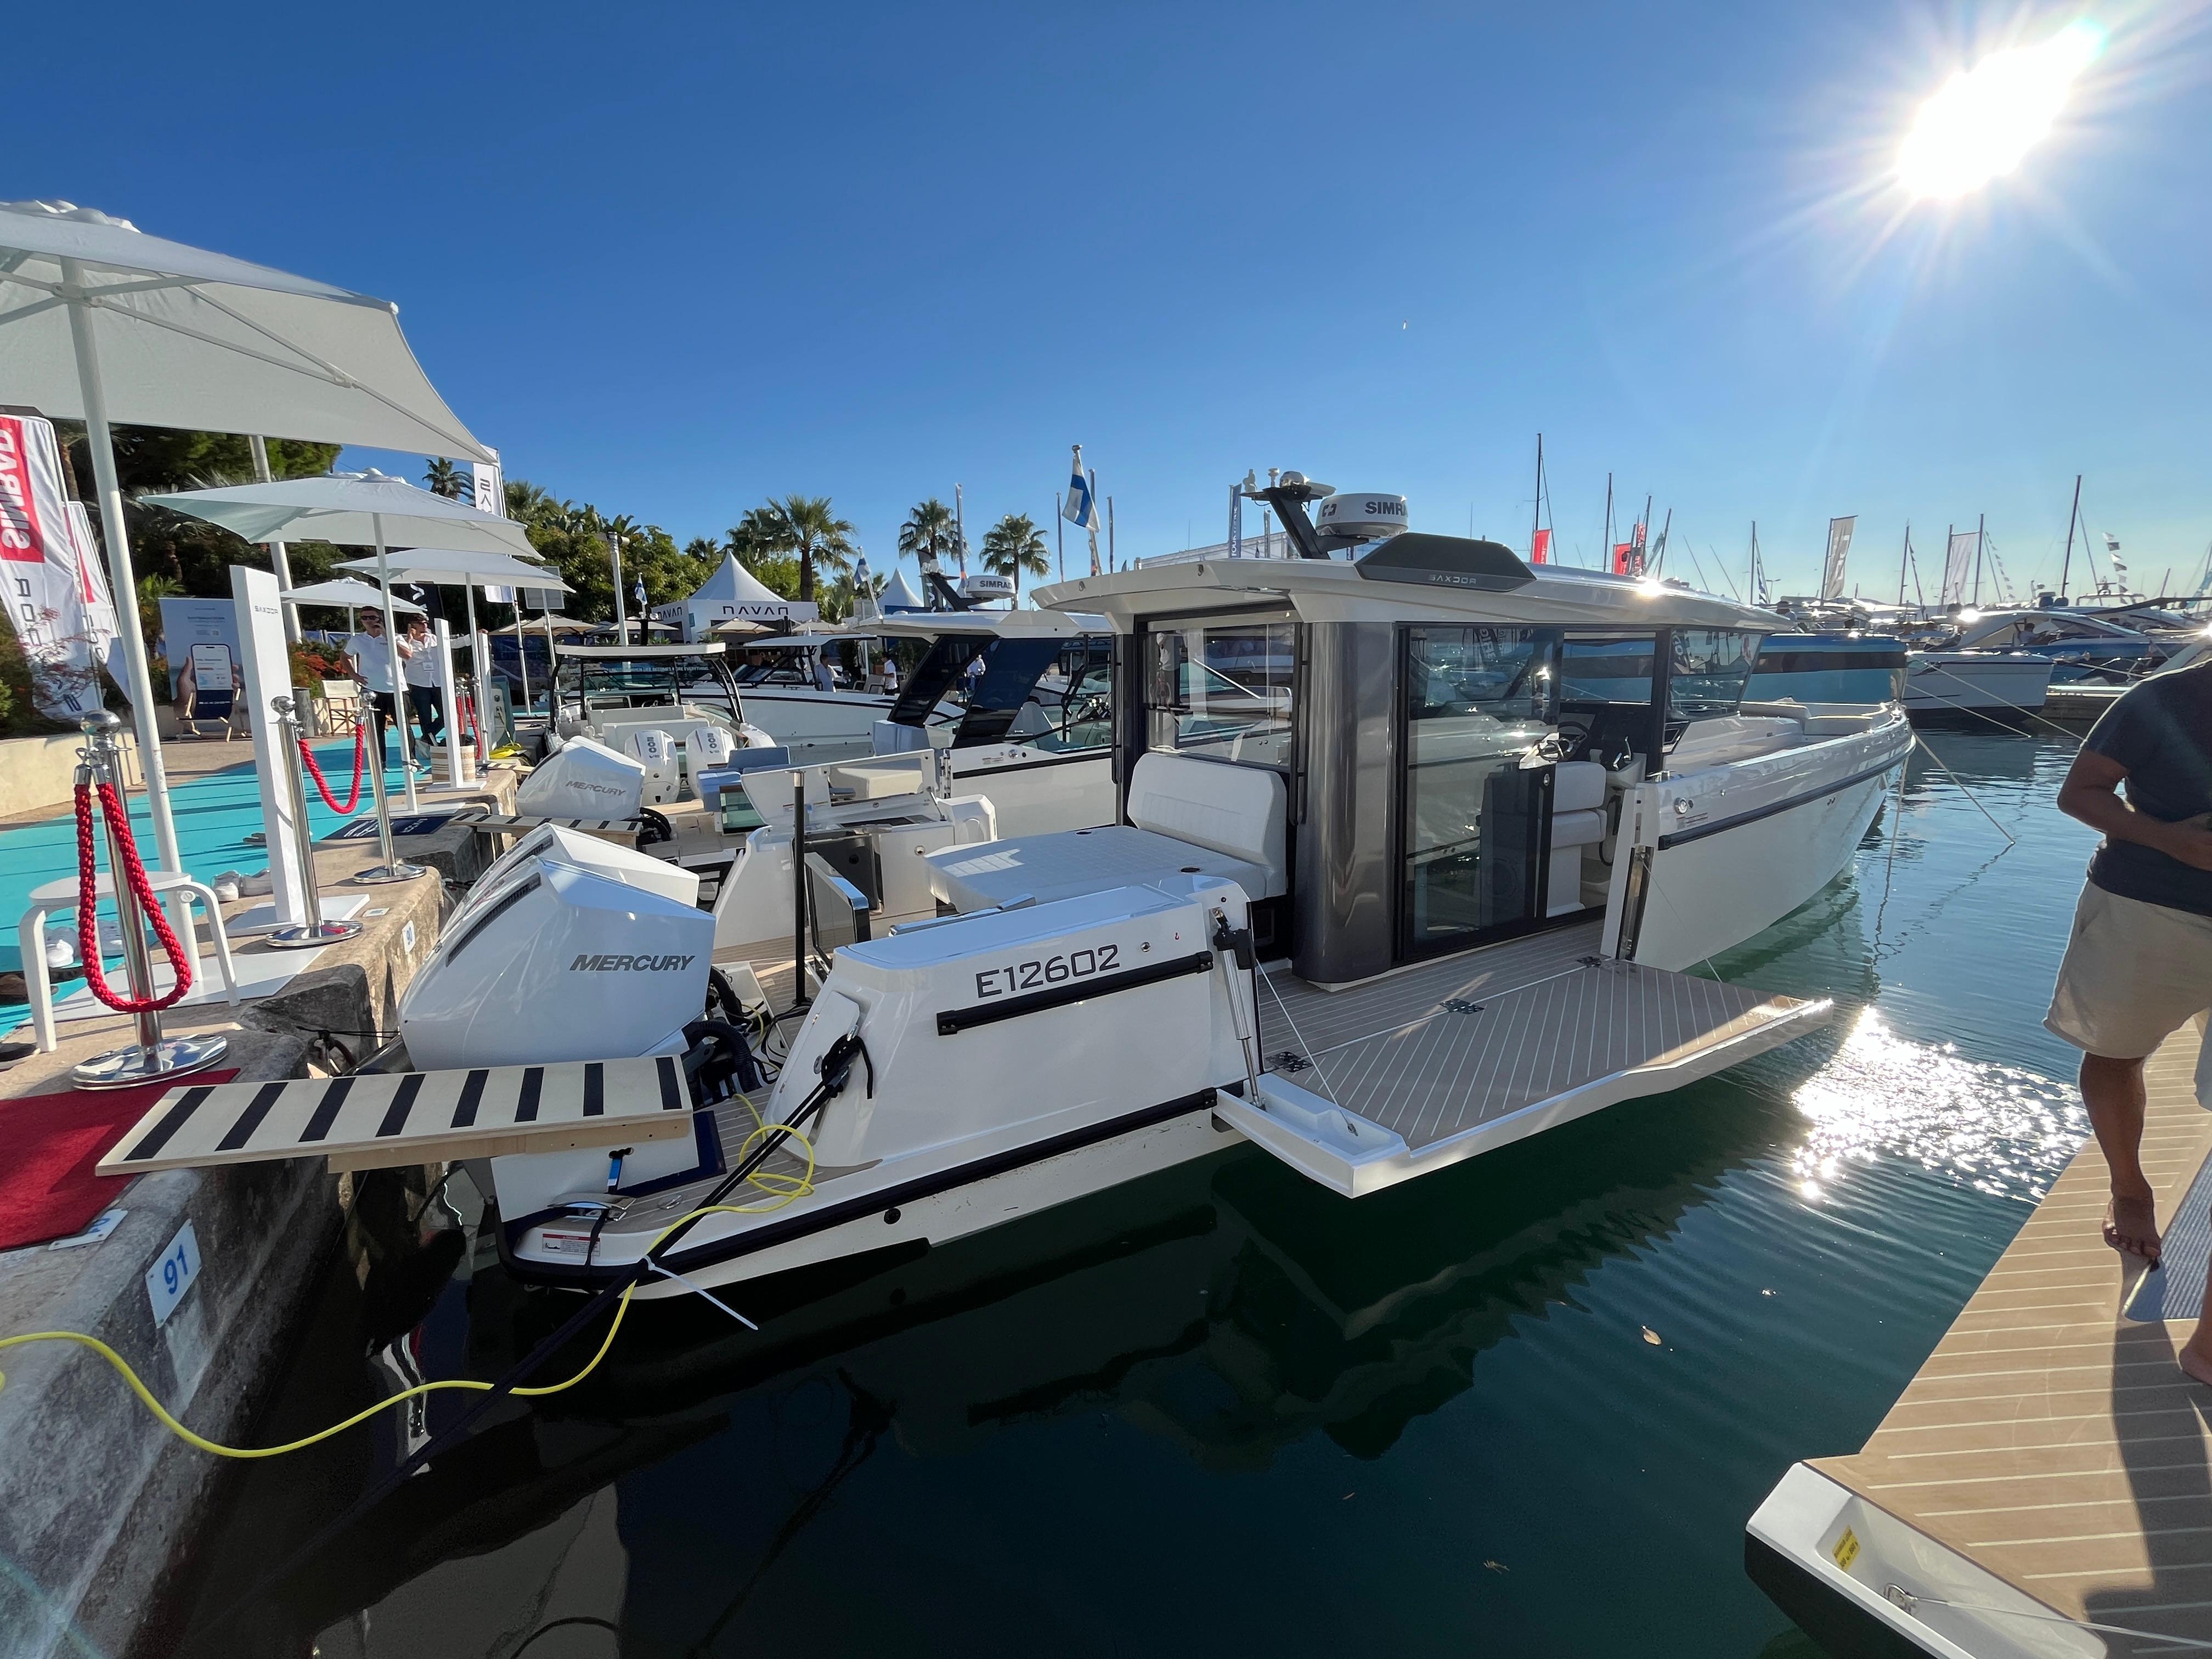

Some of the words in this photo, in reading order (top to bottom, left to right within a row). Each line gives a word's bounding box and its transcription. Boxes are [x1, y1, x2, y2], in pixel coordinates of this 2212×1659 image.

[1365, 501, 1408, 518] SIMRA
[979, 580, 1012, 589] SIMRAD
[1428, 574, 1477, 584] SAXDOR
[723, 606, 788, 616] NAVAN
[565, 781, 626, 796] MERCURY
[569, 955, 696, 971] MERCURY
[976, 944, 1120, 998] E12602
[164, 1244, 188, 1294] 91
